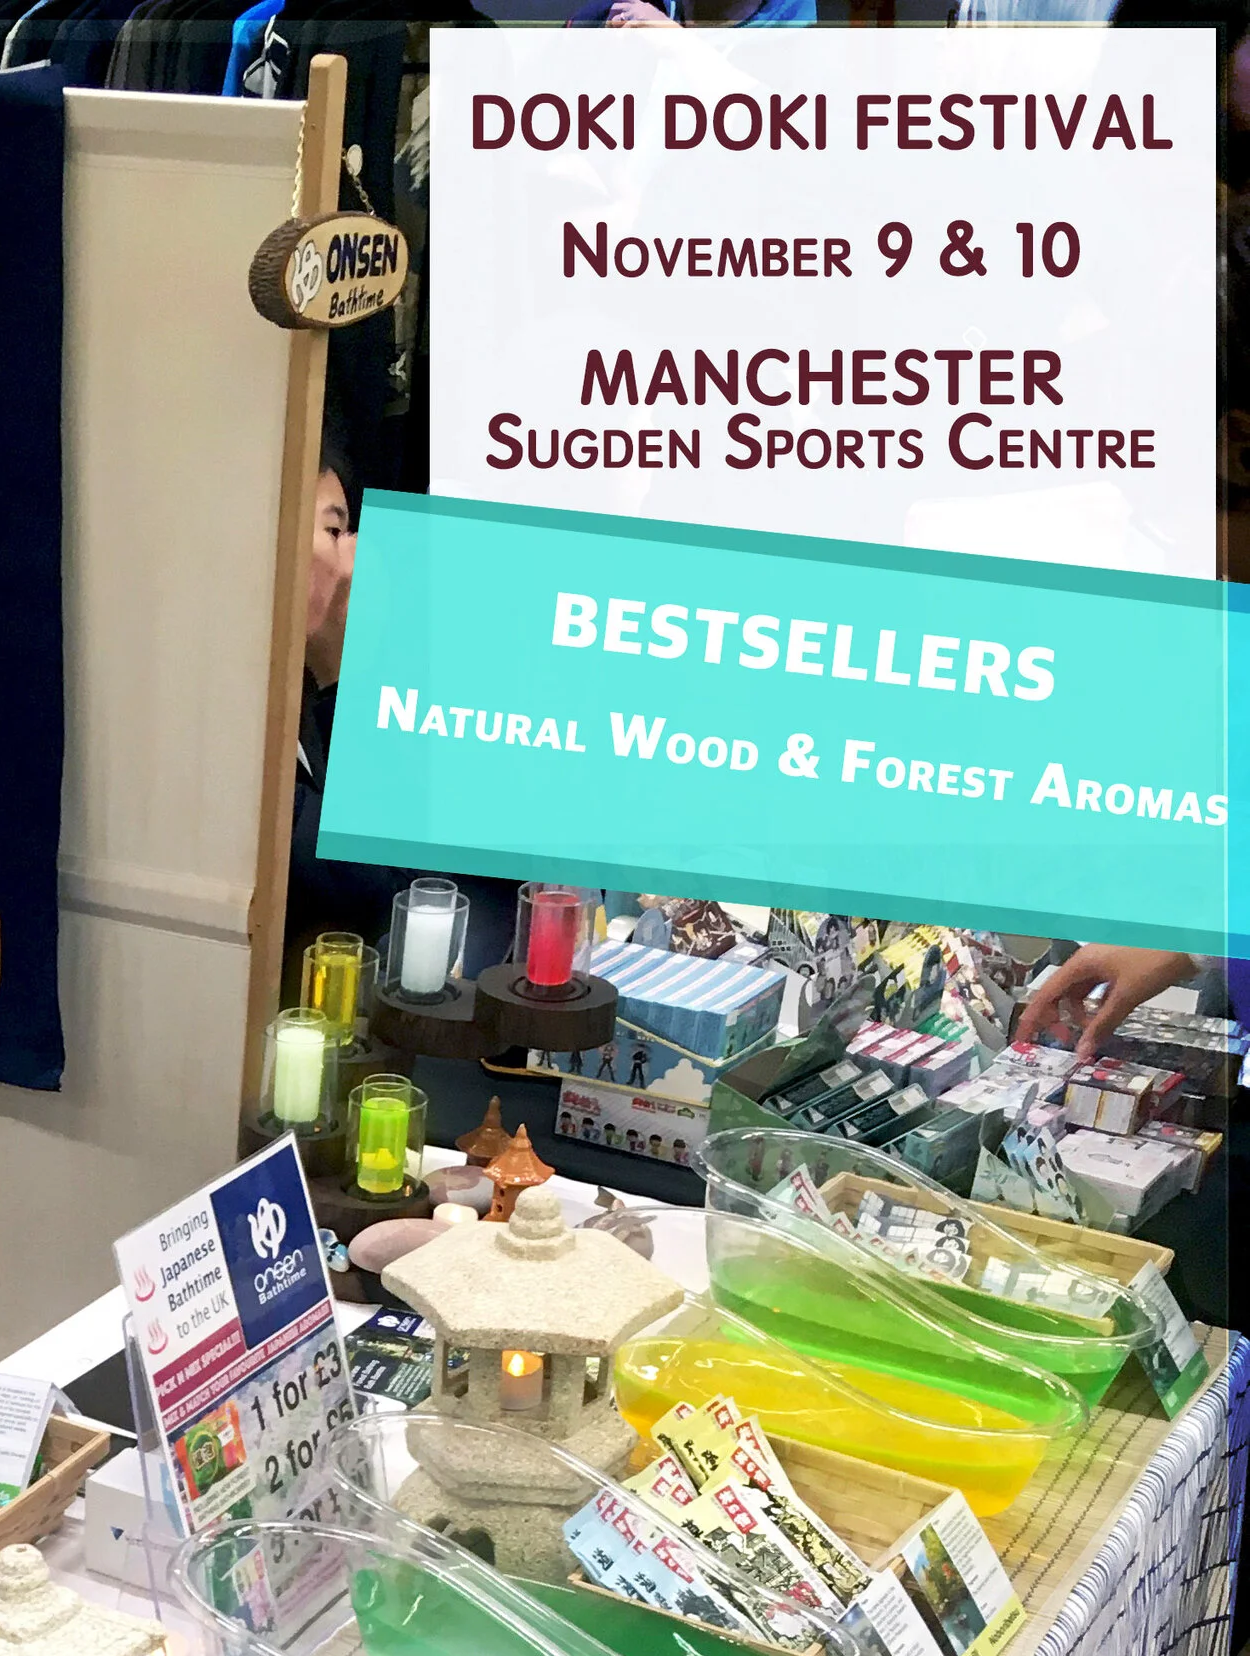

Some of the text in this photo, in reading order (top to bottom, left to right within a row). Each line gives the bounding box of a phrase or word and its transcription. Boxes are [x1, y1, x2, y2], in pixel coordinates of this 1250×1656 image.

[326, 232, 399, 284] ONSEN
[328, 285, 385, 320] Bathtime
[158, 1211, 209, 1252] Bringing
[160, 1238, 216, 1289] Japanese
[254, 1249, 303, 1292] onsen
[259, 1267, 307, 1305] Bathtime
[167, 1266, 222, 1312] Bathtime
[176, 1289, 230, 1339] to the UK
[251, 1395, 266, 1431] 1
[273, 1370, 308, 1418] for
[314, 1341, 342, 1389] £3
[264, 1454, 284, 1494] 2
[286, 1429, 320, 1477] for
